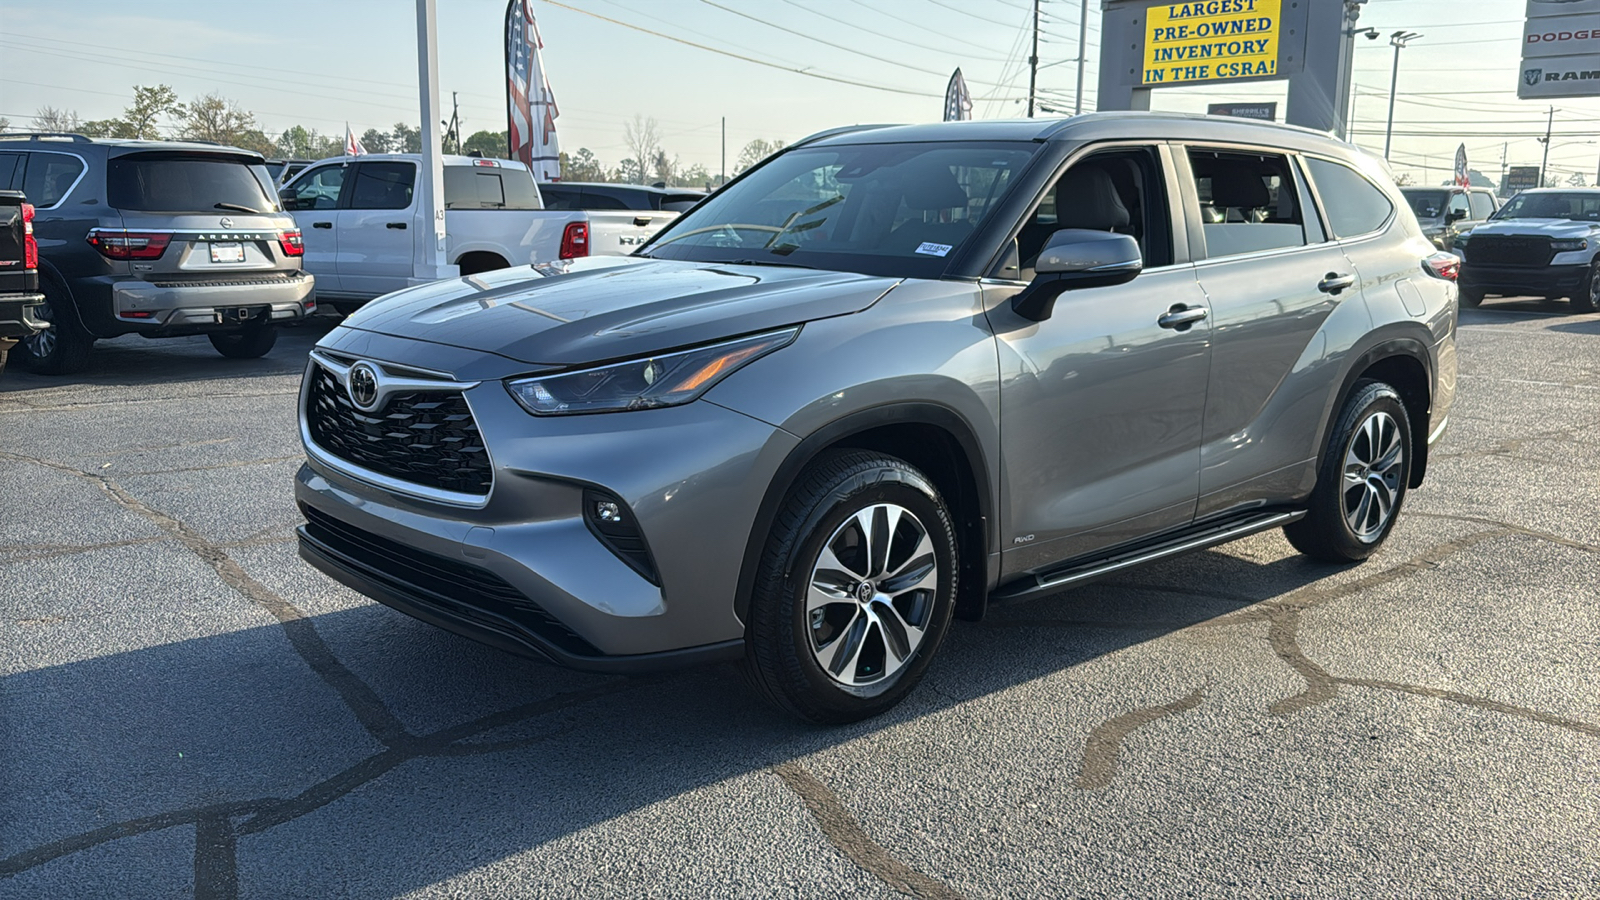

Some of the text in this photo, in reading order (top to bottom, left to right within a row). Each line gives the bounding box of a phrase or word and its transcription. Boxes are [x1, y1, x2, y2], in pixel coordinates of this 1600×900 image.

[1169, 0, 1257, 18] LARGEST
[1154, 17, 1272, 40] PRE-OWNED
[1527, 30, 1600, 43] DODGE
[1154, 39, 1269, 61] INVENTORY
[1145, 60, 1276, 82] IN THE CSRA!
[1545, 71, 1600, 81] RAM
[435, 210, 444, 220] A3
[619, 235, 651, 246] RA
[1013, 534, 1035, 544] AWD
